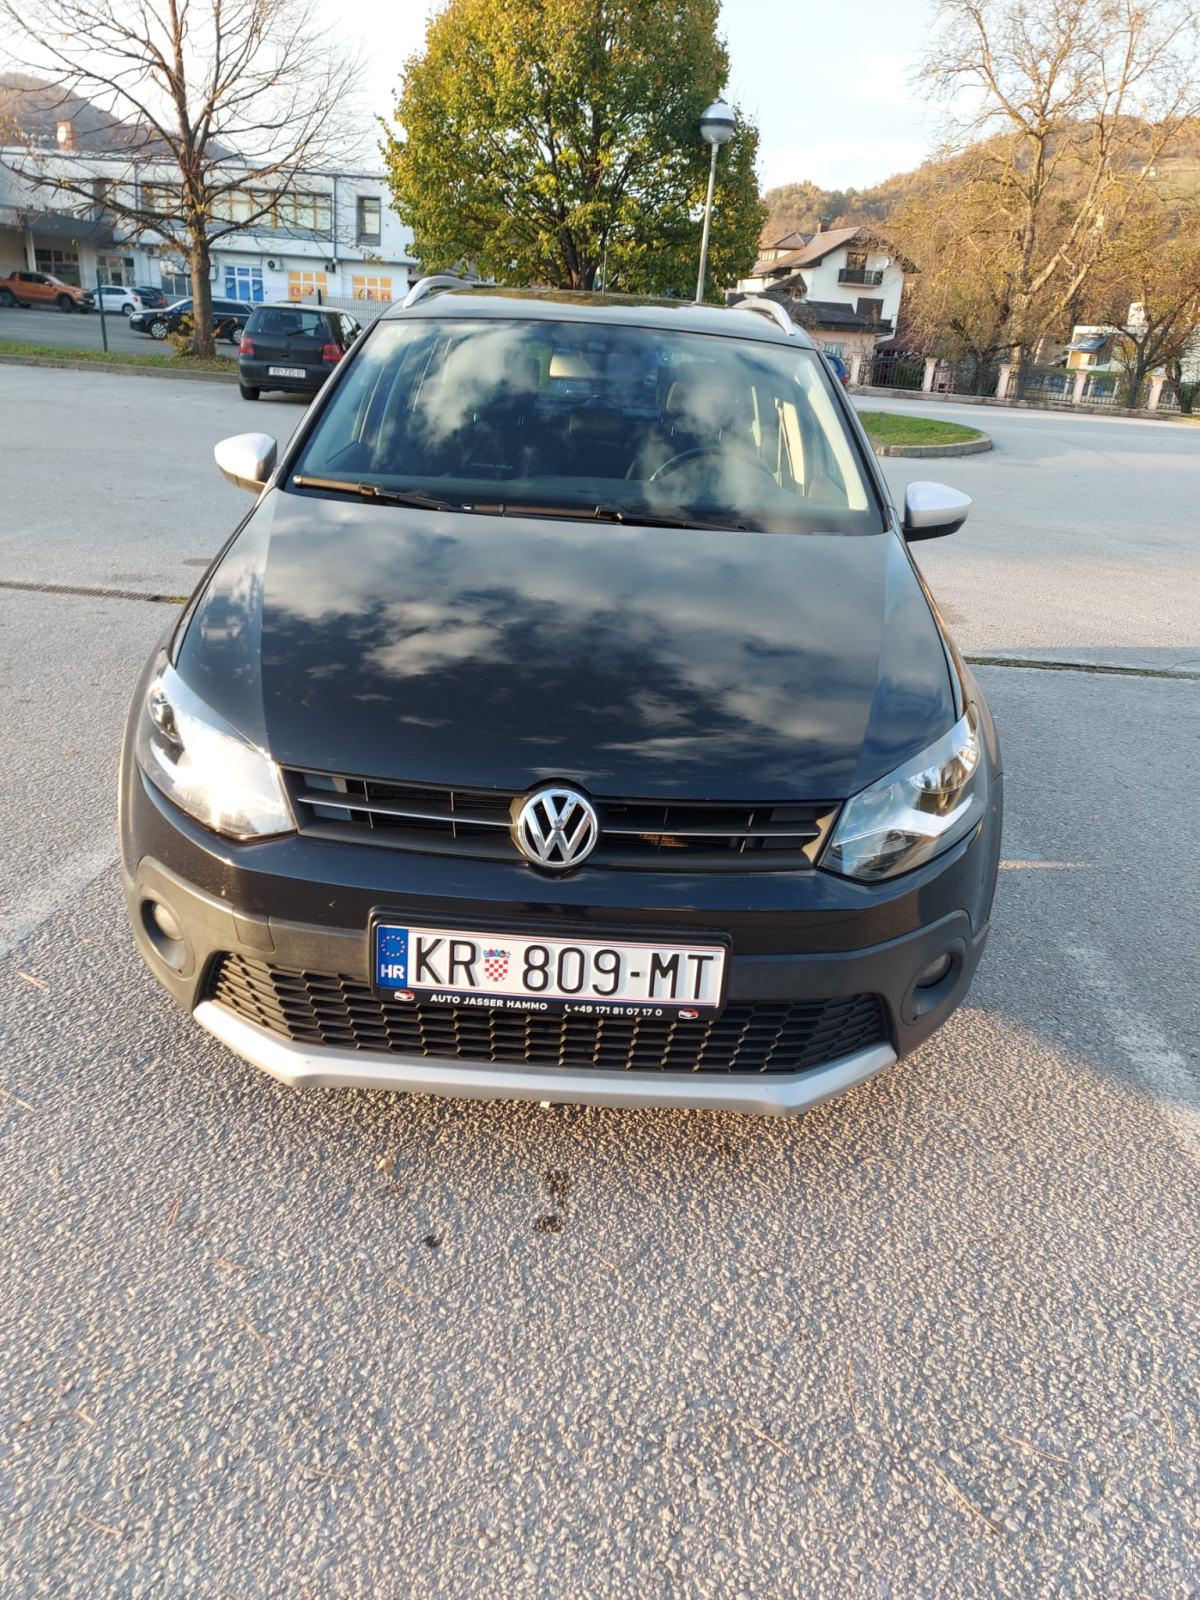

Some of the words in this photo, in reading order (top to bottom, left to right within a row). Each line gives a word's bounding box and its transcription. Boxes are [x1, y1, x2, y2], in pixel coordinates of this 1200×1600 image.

[520, 790, 597, 867] VW
[381, 964, 405, 979] HR
[416, 937, 476, 987] KR
[522, 944, 714, 1000] 809-MT
[430, 994, 460, 1004] AUTO
[463, 997, 504, 1008] JASSER
[507, 1000, 548, 1011] HAMMO
[573, 1005, 592, 1014] +49
[595, 1006, 610, 1014] 171
[612, 1007, 624, 1015] 81
[626, 1008, 639, 1016] 07
[642, 1008, 652, 1017] 17
[655, 1009, 663, 1017] 0
